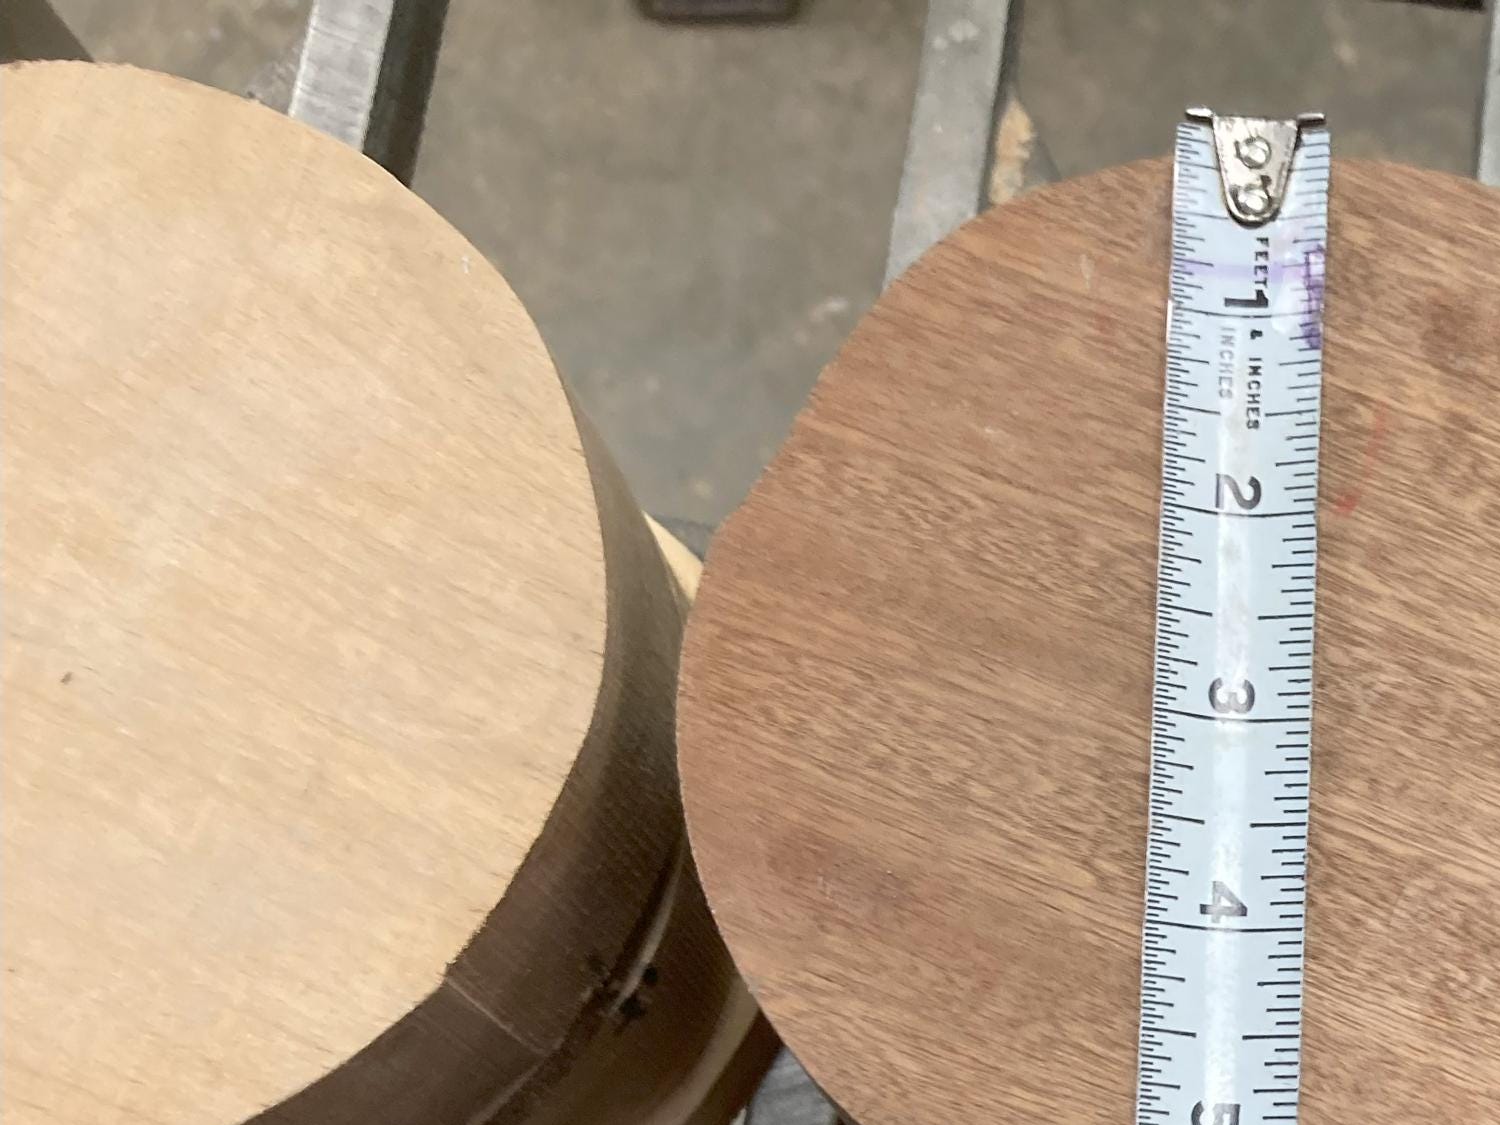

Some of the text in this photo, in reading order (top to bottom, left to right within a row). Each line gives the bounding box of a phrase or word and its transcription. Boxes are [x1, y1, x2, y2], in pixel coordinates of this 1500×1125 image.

[1224, 289, 1269, 307] 1
[1246, 237, 1270, 430] FEET & INCHES
[1218, 327, 1235, 399] INCHES
[1215, 473, 1262, 510] 2
[1208, 677, 1255, 714] 3
[1200, 881, 1248, 923] 4
